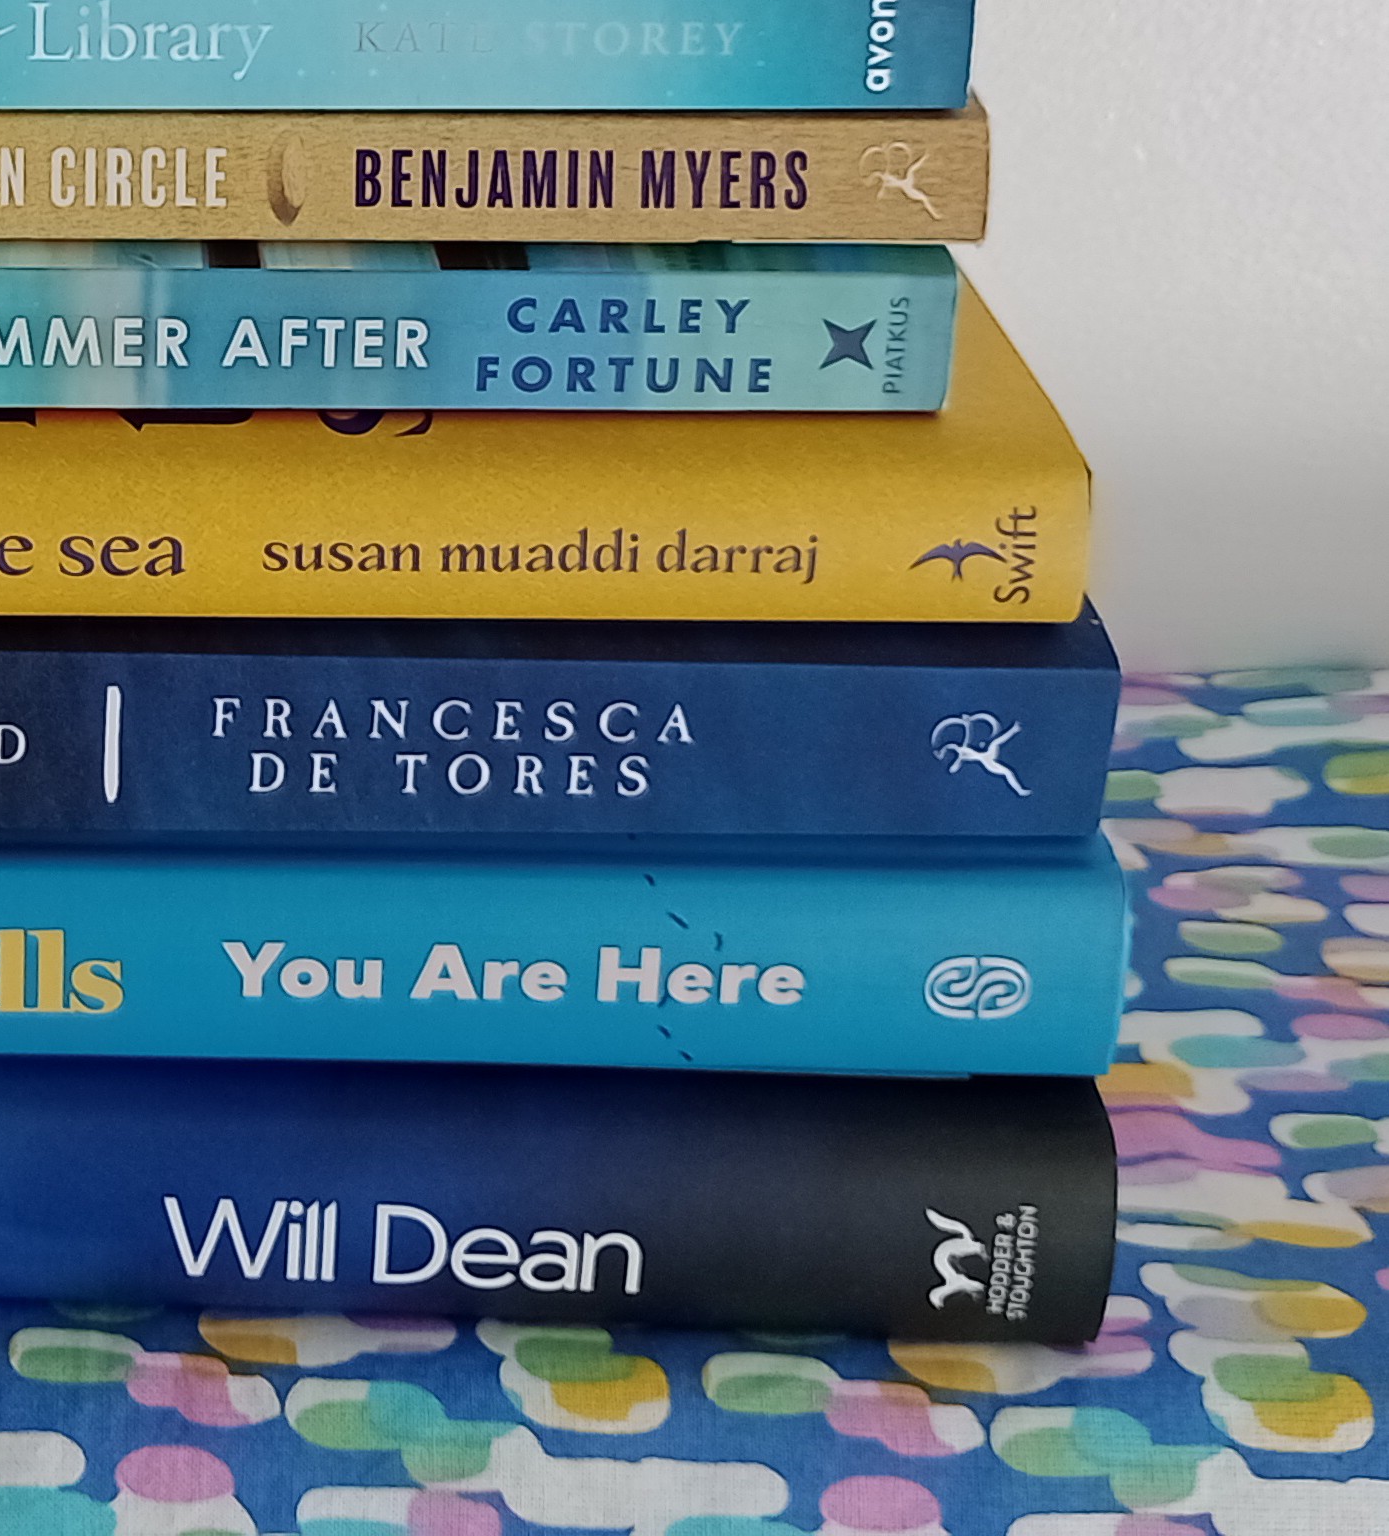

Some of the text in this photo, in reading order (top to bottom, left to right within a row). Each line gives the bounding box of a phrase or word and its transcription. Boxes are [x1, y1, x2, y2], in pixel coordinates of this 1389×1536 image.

[354, 20, 746, 57] KATE STOREY
[51, 147, 228, 208] CIRCLE
[354, 149, 809, 211] BENJAMIN MYERS
[222, 318, 430, 369] AFTER
[507, 297, 751, 336] CARLEY
[882, 296, 910, 394] PIATKUS
[476, 356, 772, 394] FORTUNE
[58, 535, 186, 578] sea
[261, 527, 819, 585] susan muaddi darraj
[993, 505, 1038, 607] Swift
[212, 695, 694, 745] FRANCESCA
[249, 752, 651, 798] DE TORES
[222, 941, 806, 1006] You Are Here
[162, 1195, 644, 1296] Will Dean
[985, 1233, 1015, 1315] HODDER
